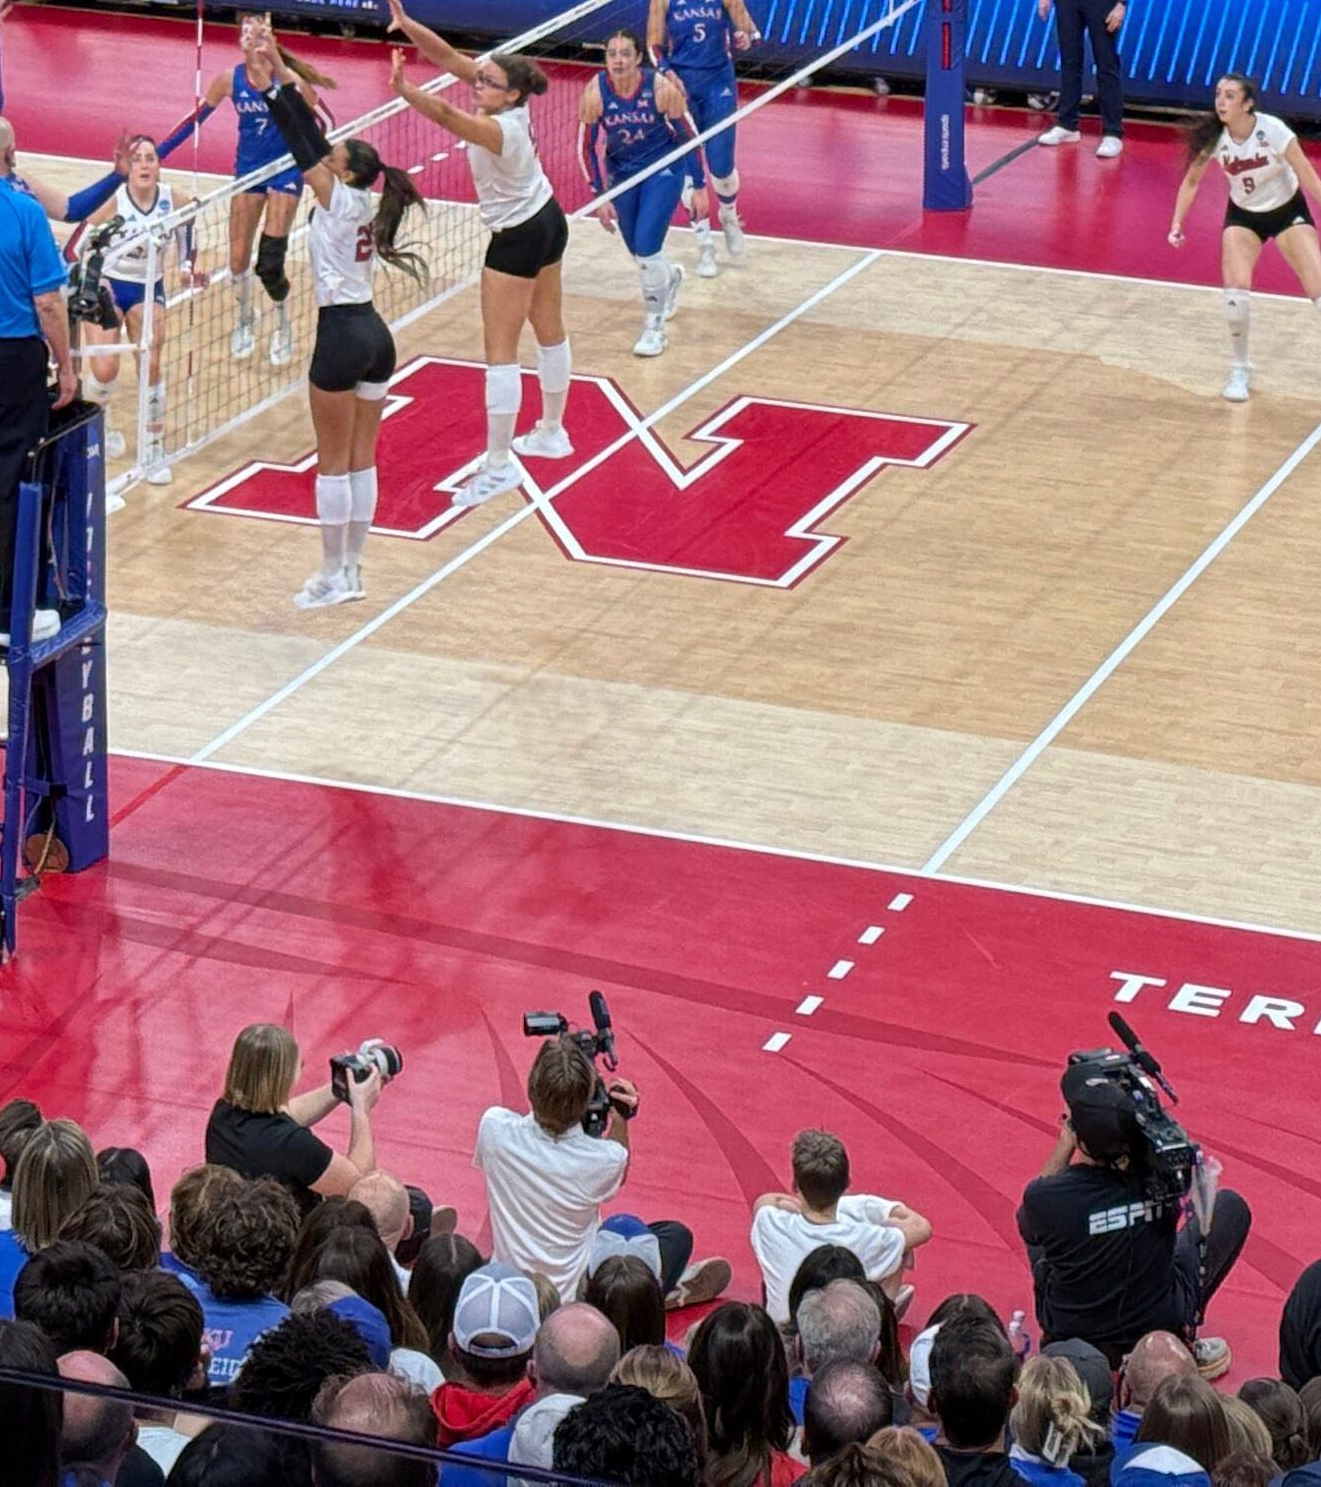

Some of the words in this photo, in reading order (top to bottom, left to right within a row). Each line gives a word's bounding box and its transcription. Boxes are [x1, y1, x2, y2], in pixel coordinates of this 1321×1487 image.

[692, 23, 706, 43] 5
[236, 101, 270, 113] KANS
[255, 117, 268, 135] 7
[619, 128, 645, 145] 24
[181, 354, 977, 590] N
[1089, 1200, 1163, 1235] ESPN
